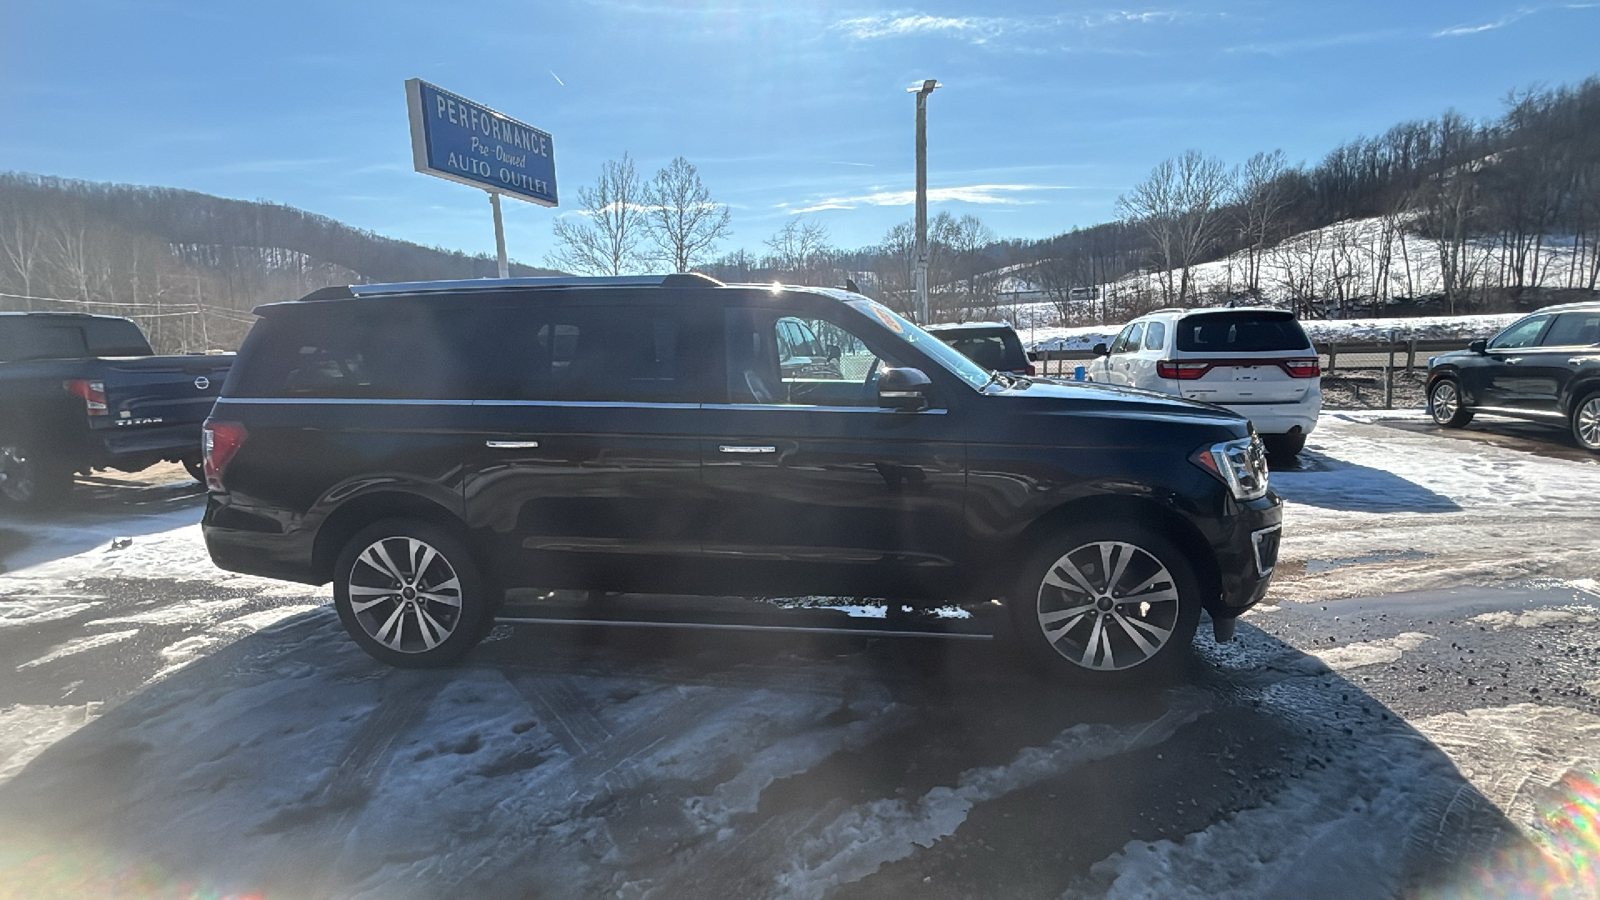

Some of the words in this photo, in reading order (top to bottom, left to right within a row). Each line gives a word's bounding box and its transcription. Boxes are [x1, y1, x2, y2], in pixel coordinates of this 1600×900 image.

[436, 94, 548, 158] PERFORMANCE
[448, 152, 491, 178] AUTO
[500, 168, 548, 195] OUTLET
[471, 136, 526, 168] Pre-Owned
